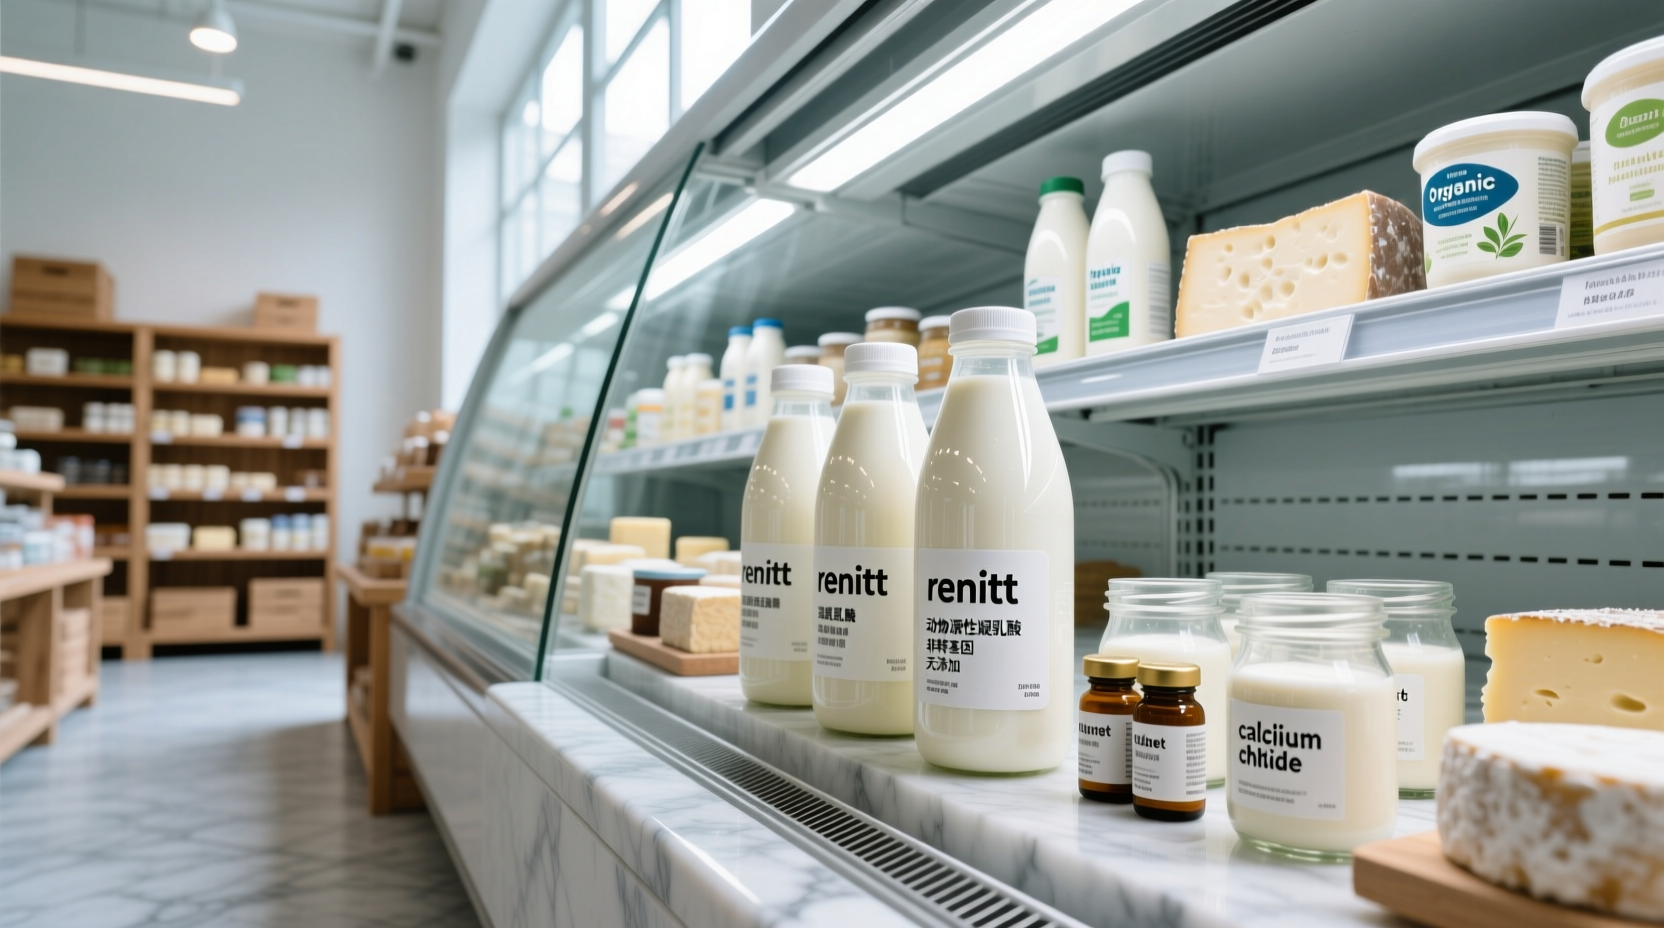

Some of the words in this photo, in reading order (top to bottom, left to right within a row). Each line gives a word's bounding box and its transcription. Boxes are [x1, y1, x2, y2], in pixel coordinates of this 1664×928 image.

[818, 565, 888, 596] renitt
[928, 569, 1019, 605] renitt
[1238, 721, 1322, 750] calciium
